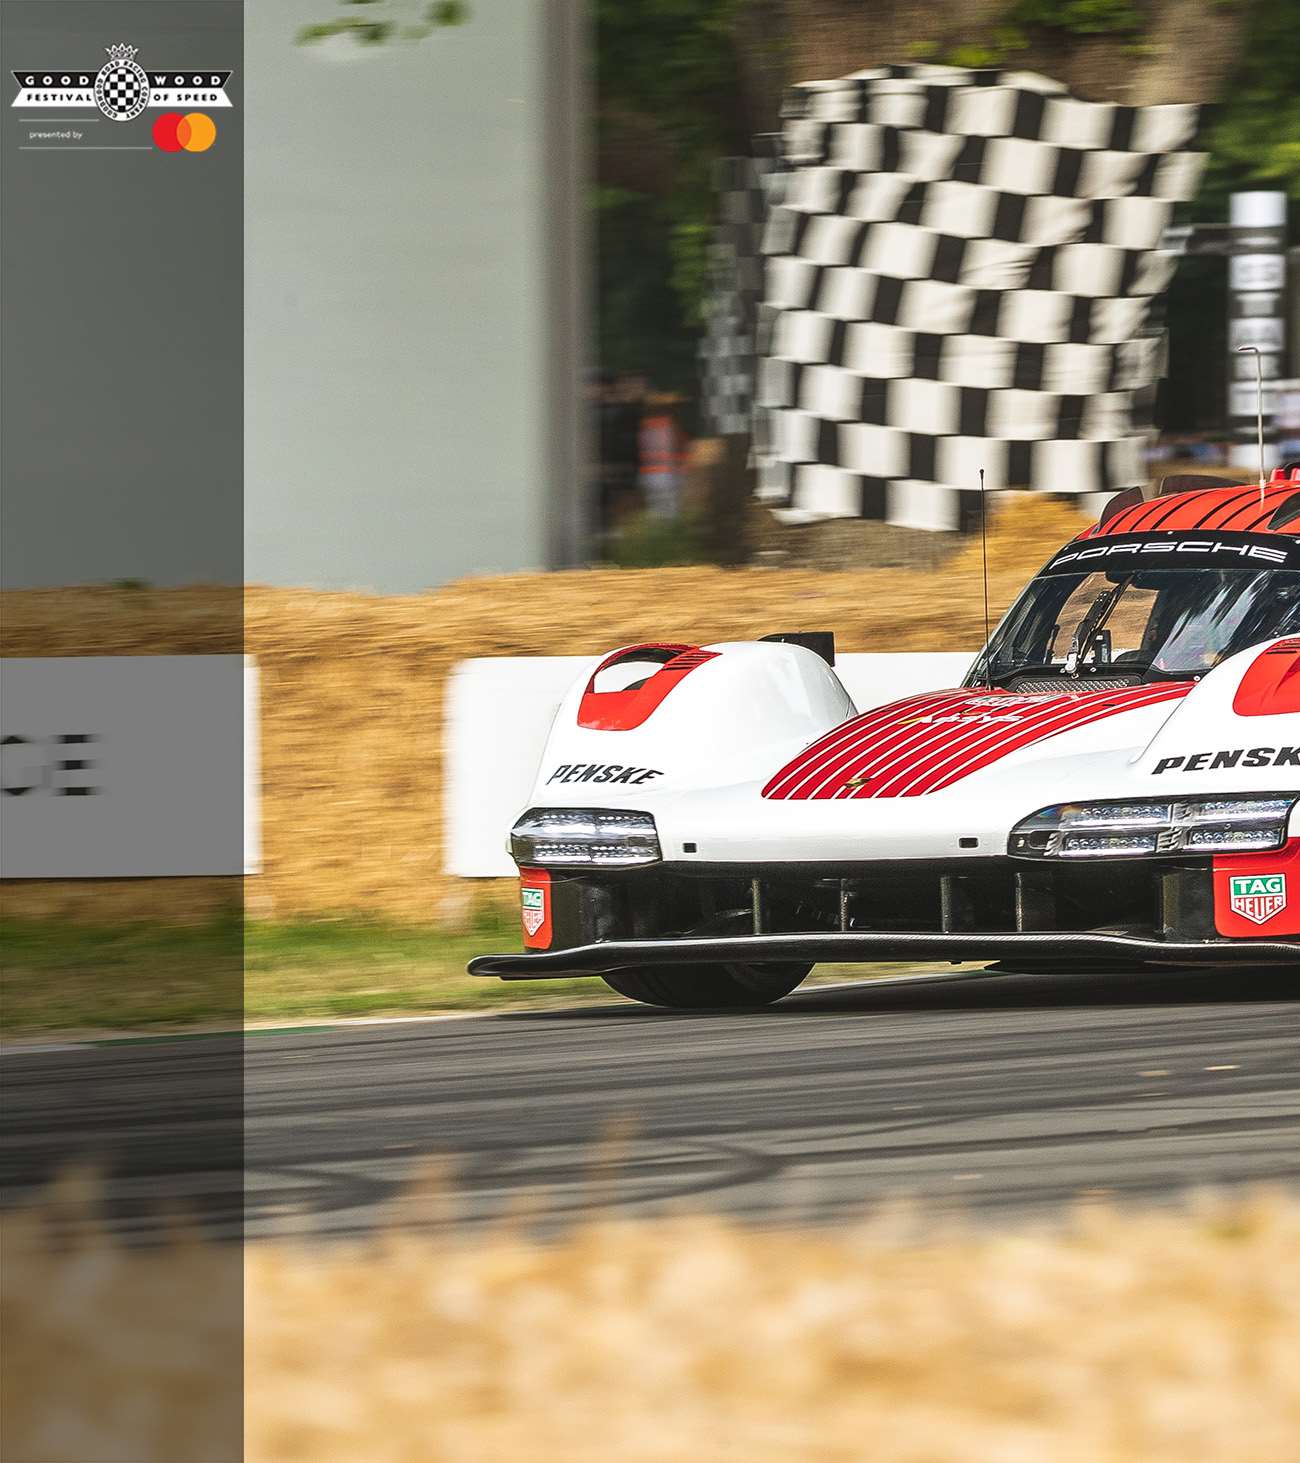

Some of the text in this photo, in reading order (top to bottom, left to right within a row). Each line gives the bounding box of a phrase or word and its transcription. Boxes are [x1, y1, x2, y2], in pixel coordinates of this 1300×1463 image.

[1050, 541, 1289, 570] PORSCHE
[546, 763, 664, 786] PENSKE
[1234, 877, 1282, 894] TAG
[1234, 895, 1284, 917] HEUER
